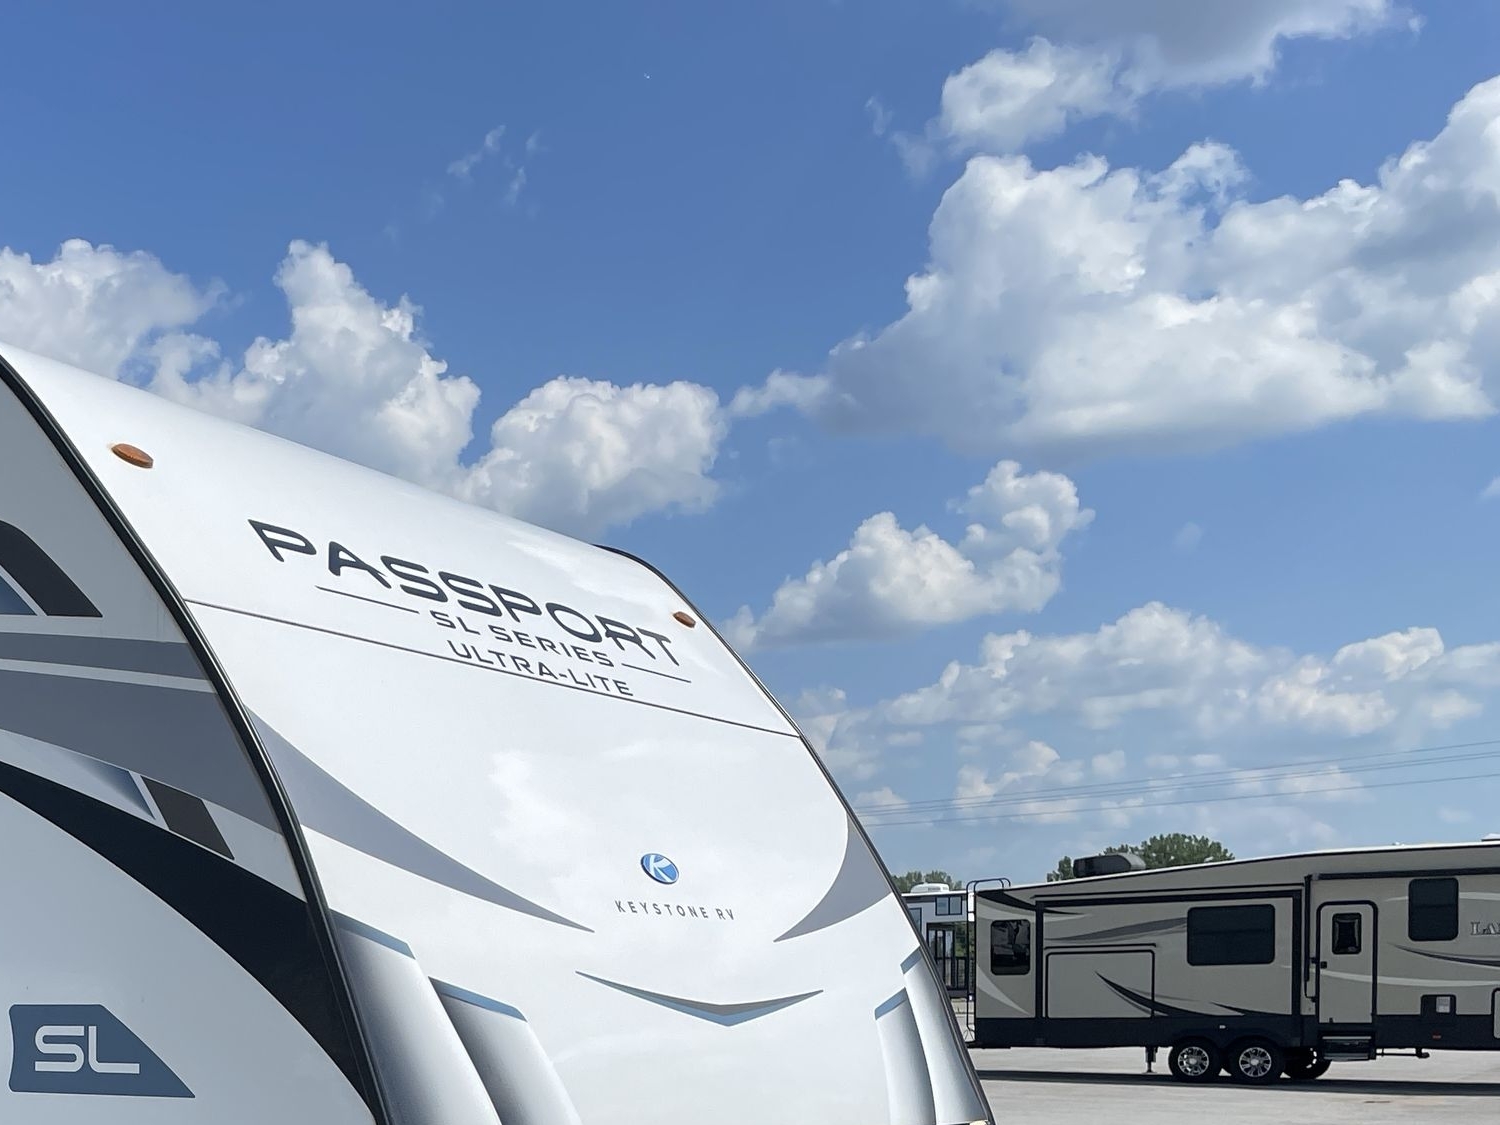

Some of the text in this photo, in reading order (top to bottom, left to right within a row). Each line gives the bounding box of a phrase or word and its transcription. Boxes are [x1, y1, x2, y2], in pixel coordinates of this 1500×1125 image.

[248, 518, 681, 667] PASSPORT
[429, 610, 626, 668] SL SERIES
[446, 639, 634, 698] ULTRA-LITE
[614, 899, 735, 921] KEYSTONE RV
[1470, 921, 1500, 936] LA
[34, 1025, 140, 1075] SL
